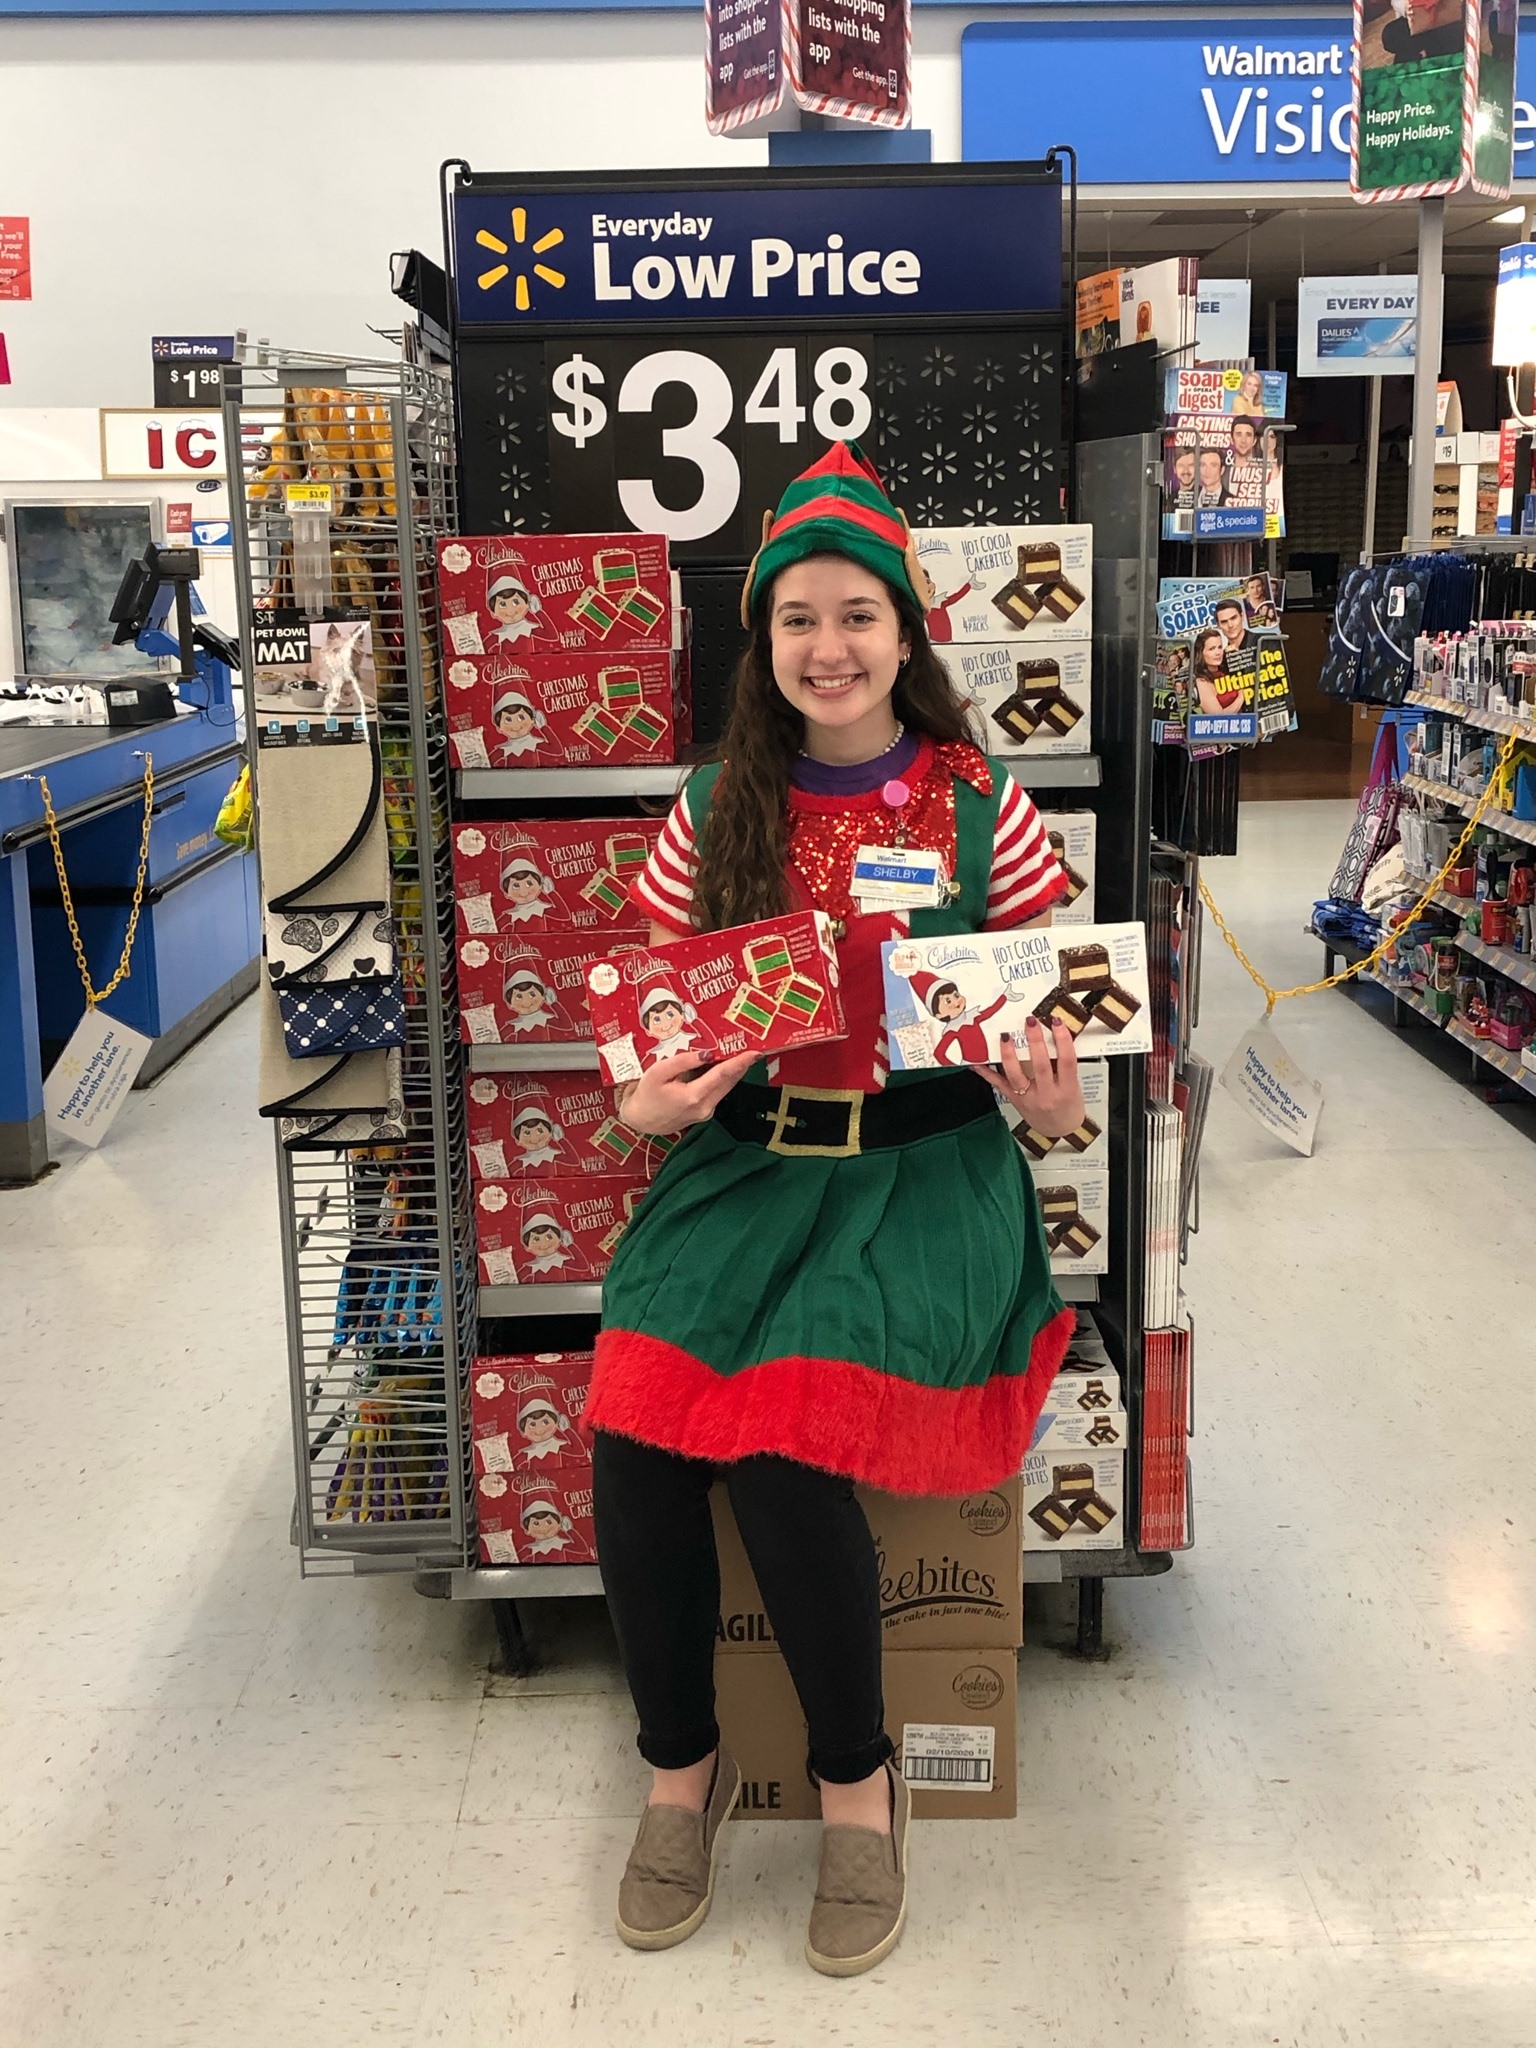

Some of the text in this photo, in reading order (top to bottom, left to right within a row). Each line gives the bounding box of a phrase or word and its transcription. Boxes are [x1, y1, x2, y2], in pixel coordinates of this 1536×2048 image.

[718, 16, 767, 51] lists with the
[808, 7, 881, 44] lists with the
[809, 43, 831, 64] app
[1201, 44, 1343, 76] Walmart
[719, 62, 734, 83] app
[743, 68, 752, 79] Get
[752, 65, 760, 76] the
[852, 67, 889, 88] Get the app.
[1366, 102, 1435, 126] Happy Price.
[1365, 123, 1454, 148] Happy Holidays.
[592, 213, 713, 243] Everyday
[593, 233, 922, 302] Low Price
[1327, 296, 1416, 310] EVERY DAY
[1321, 328, 1353, 337] DAILIES
[170, 345, 218, 355] Low Price
[1179, 371, 1224, 391] soap
[1178, 390, 1223, 412] digest
[1177, 415, 1234, 431] CASTING
[1174, 432, 1231, 448] SHOCKERS
[1225, 449, 1235, 465] &
[1232, 467, 1272, 483] MUST
[309, 490, 329, 499] $3.97
[1237, 483, 1262, 498] SEE
[1200, 512, 1216, 521] soap
[1225, 498, 1280, 513] STORIS!
[1216, 516, 1225, 529] &
[1225, 514, 1258, 526] specials
[961, 532, 1012, 557] HOT COCOA
[531, 557, 584, 583] CHRISTMAS
[966, 550, 1014, 574] CAKEBITES
[537, 573, 586, 599] CAKEBITES
[1171, 595, 1206, 612] CBS
[256, 627, 308, 638] PET BOWL
[968, 621, 989, 632] PACKS
[257, 640, 309, 662] MAT
[565, 634, 587, 648] PACKS
[961, 648, 1012, 672] HOT COCOA
[1259, 649, 1282, 665] The
[536, 673, 589, 698] CHRISTMAS
[966, 665, 1013, 690] CAKEBITES
[543, 691, 590, 714] CAKEBITES
[570, 750, 591, 763] PACKS
[544, 840, 596, 865] CHRISTMAS
[876, 855, 907, 864] Walmart
[551, 857, 597, 880] CAKEBITES
[873, 866, 920, 880] SHELBY
[577, 914, 598, 927] PACKS
[927, 944, 981, 970] Cakebites
[992, 935, 1052, 967] HOT COCOA
[547, 951, 597, 976] CHRISTMAS
[622, 956, 677, 986] Cakebites
[681, 953, 735, 989] CHRISTMAS
[999, 955, 1054, 985] CAKEBITES
[689, 973, 739, 1005] CAKEBITES
[724, 1037, 748, 1055] PACKS
[57, 1031, 115, 1120] Happy to help you
[72, 1044, 121, 1119] in another lane.
[1246, 1046, 1308, 1119] Happy to help you
[554, 1089, 605, 1114] CHRISTMAS
[1244, 1061, 1299, 1124] in another lane.
[560, 1106, 606, 1129] CAKEBITES
[586, 1160, 607, 1173] PACKS
[564, 1195, 615, 1219] CHRISTMAS
[570, 1211, 616, 1234] CAKEBITES
[959, 1499, 1005, 1520] Cookies
[715, 1613, 778, 1643] AGIL
[885, 1605, 1010, 1629] the cake in just one bite!
[952, 1672, 1001, 1694] Cookies
